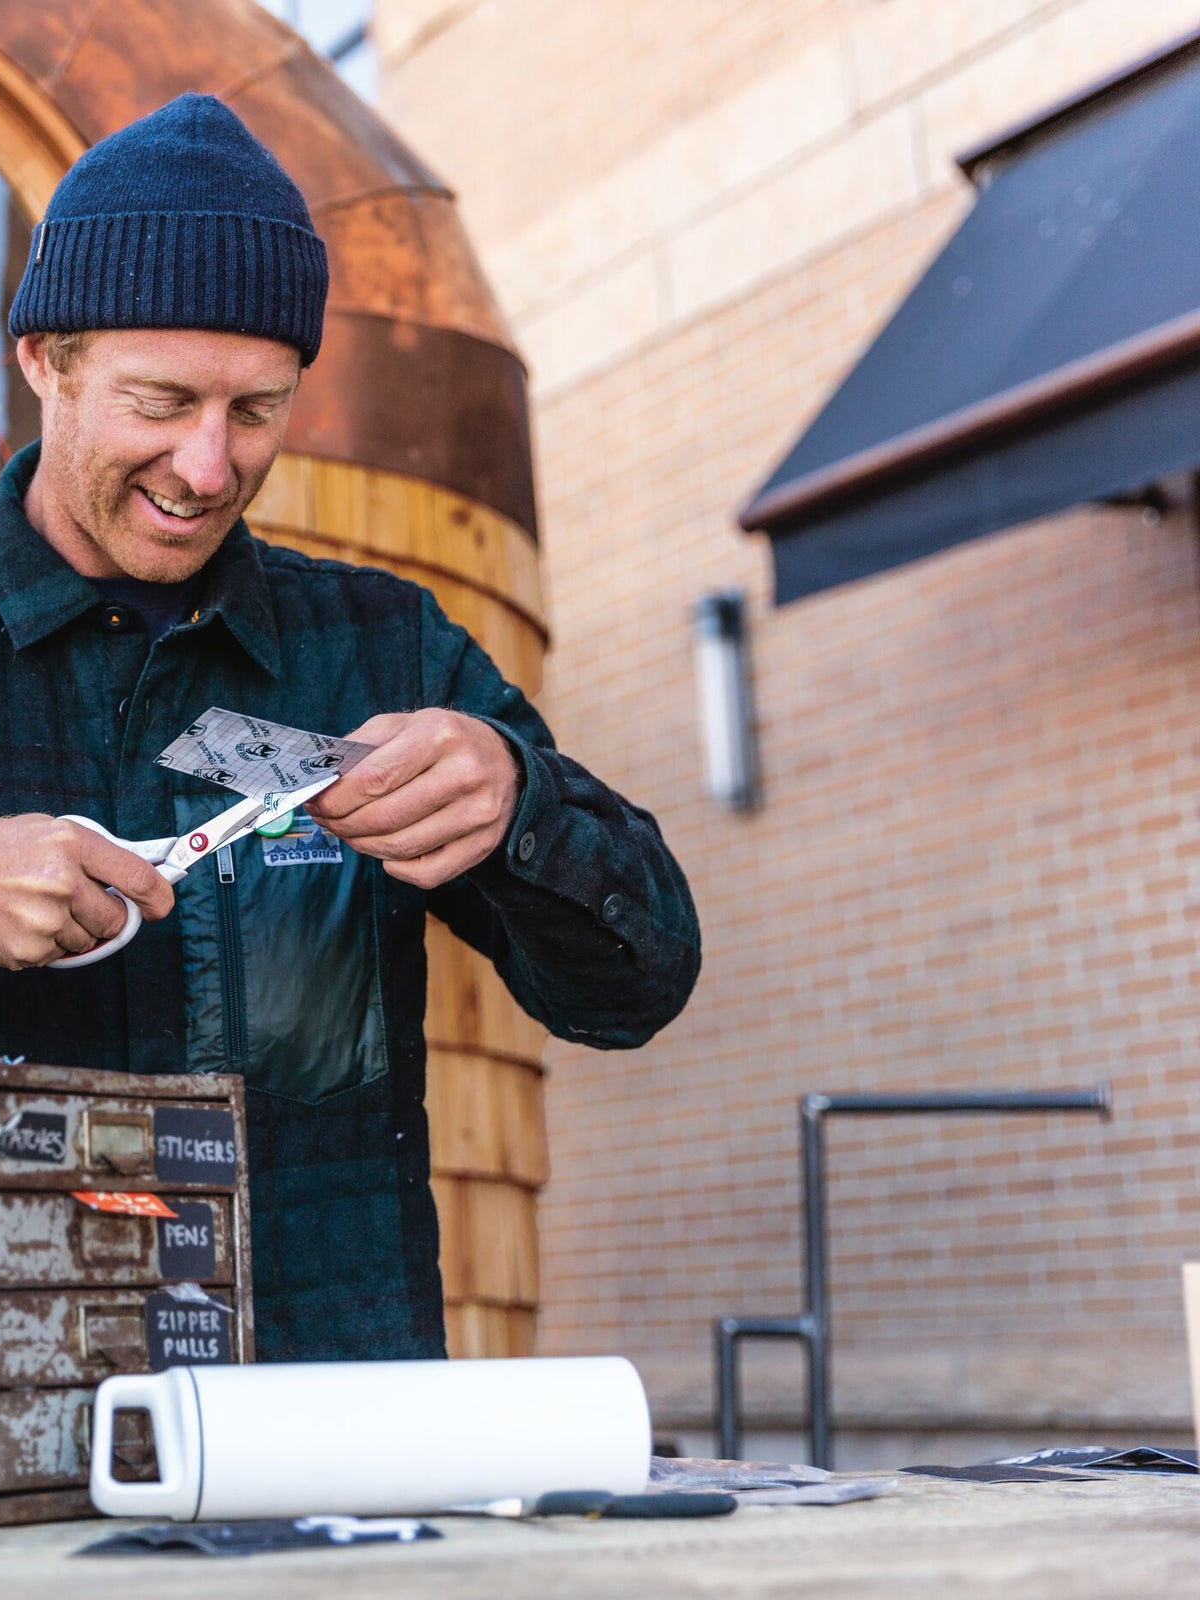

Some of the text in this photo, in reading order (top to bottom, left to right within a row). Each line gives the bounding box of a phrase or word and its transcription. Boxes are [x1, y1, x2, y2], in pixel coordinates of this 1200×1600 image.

[270, 850, 336, 862] patagonia
[158, 1135, 235, 1163] STICKERS
[165, 1223, 208, 1248] PENS
[157, 1309, 221, 1333] ZIPPER
[163, 1337, 220, 1359] PULLS
